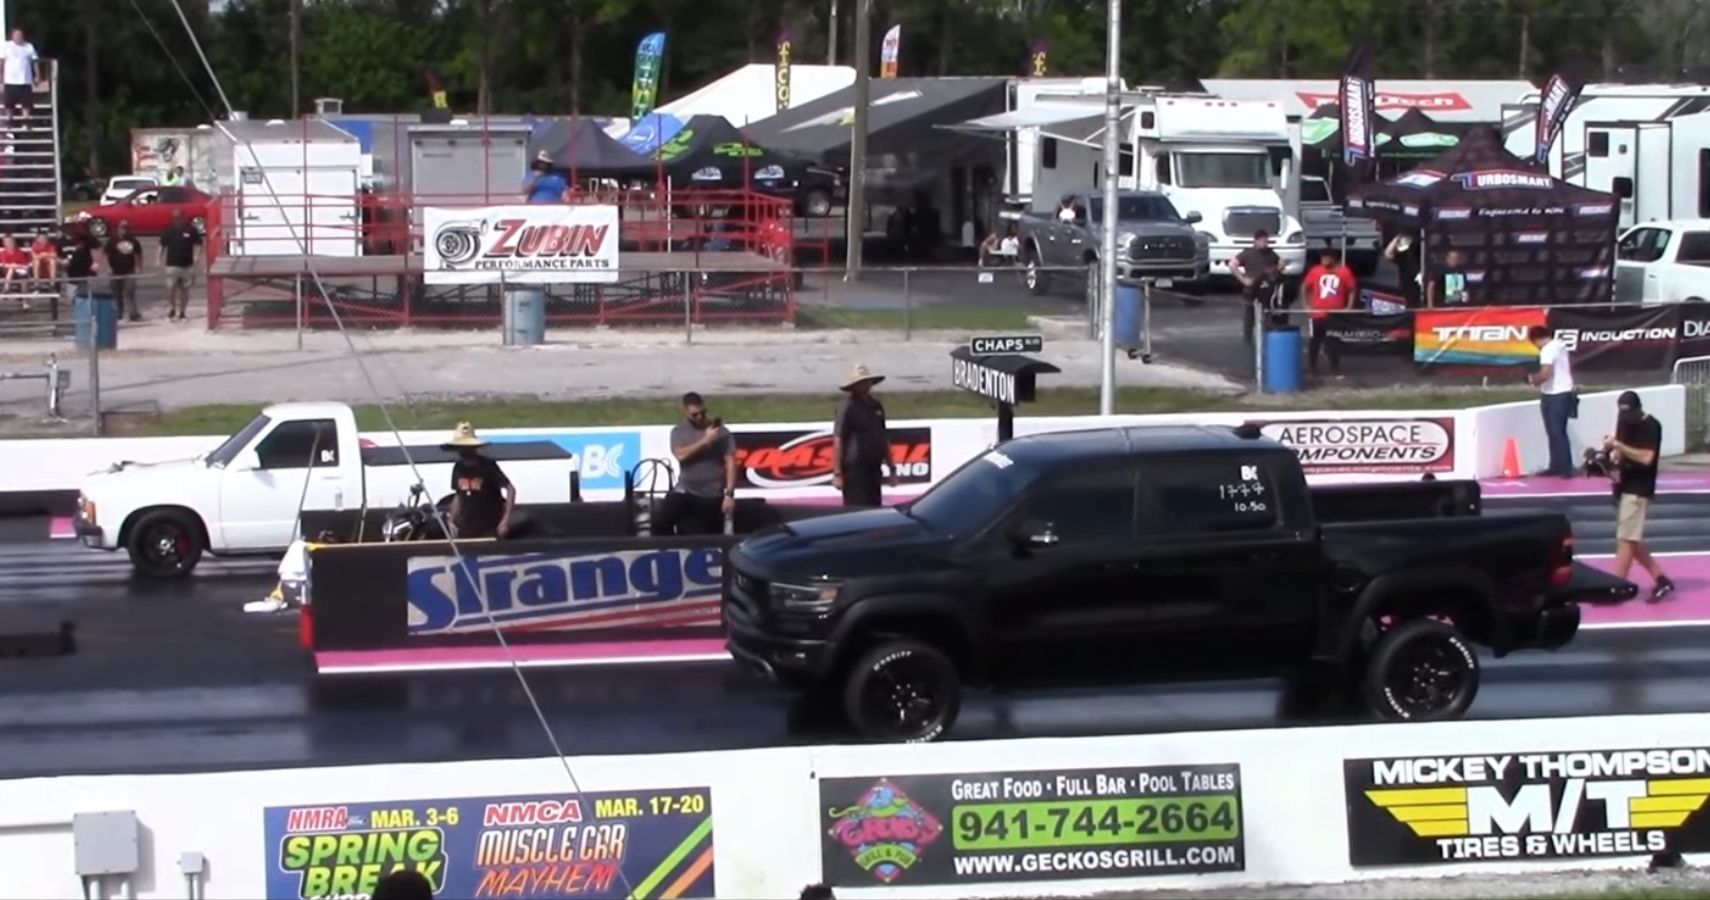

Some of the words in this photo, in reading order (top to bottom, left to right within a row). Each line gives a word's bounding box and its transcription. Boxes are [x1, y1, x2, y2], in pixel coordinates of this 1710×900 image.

[483, 219, 608, 258] ZUBIN
[475, 259, 567, 269] PERFORMANCE
[570, 259, 609, 268] PARTS
[975, 338, 1024, 351] CHAPS
[1581, 327, 1676, 342] INDUCTION
[954, 358, 1015, 404] BRADENTON
[1279, 425, 1421, 444] AEROSPACE
[1296, 447, 1436, 460] MPONENTS
[408, 550, 722, 634] Strange
[1374, 757, 1512, 784] MICKEY
[1519, 750, 1710, 778] THOMPSON
[952, 779, 999, 800] GREAT
[1003, 777, 1042, 797] FOOD
[1056, 775, 1092, 796] FULL
[1096, 773, 1126, 794] BAR
[1139, 772, 1177, 792] POOL
[1181, 771, 1235, 791] TABLES
[287, 806, 348, 832] NMRA
[371, 809, 421, 828] MAR.
[426, 807, 459, 825] 3-6
[484, 799, 583, 826] NMCA
[595, 799, 644, 818] MAR.
[649, 795, 705, 815] 17-20
[959, 801, 1234, 842] 941-744-2664
[1467, 779, 1648, 835] M/T
[284, 829, 439, 868] SPRING
[477, 827, 577, 867] MUSCLE
[580, 823, 625, 860] CAR
[1436, 836, 1520, 858] TIRES
[1526, 836, 1546, 855] &
[1552, 830, 1666, 854] WHEELS
[954, 846, 1235, 875] WWW.GECKOSGRILL.COM
[304, 861, 441, 898] BREK
[476, 862, 618, 897] MAYHEM
